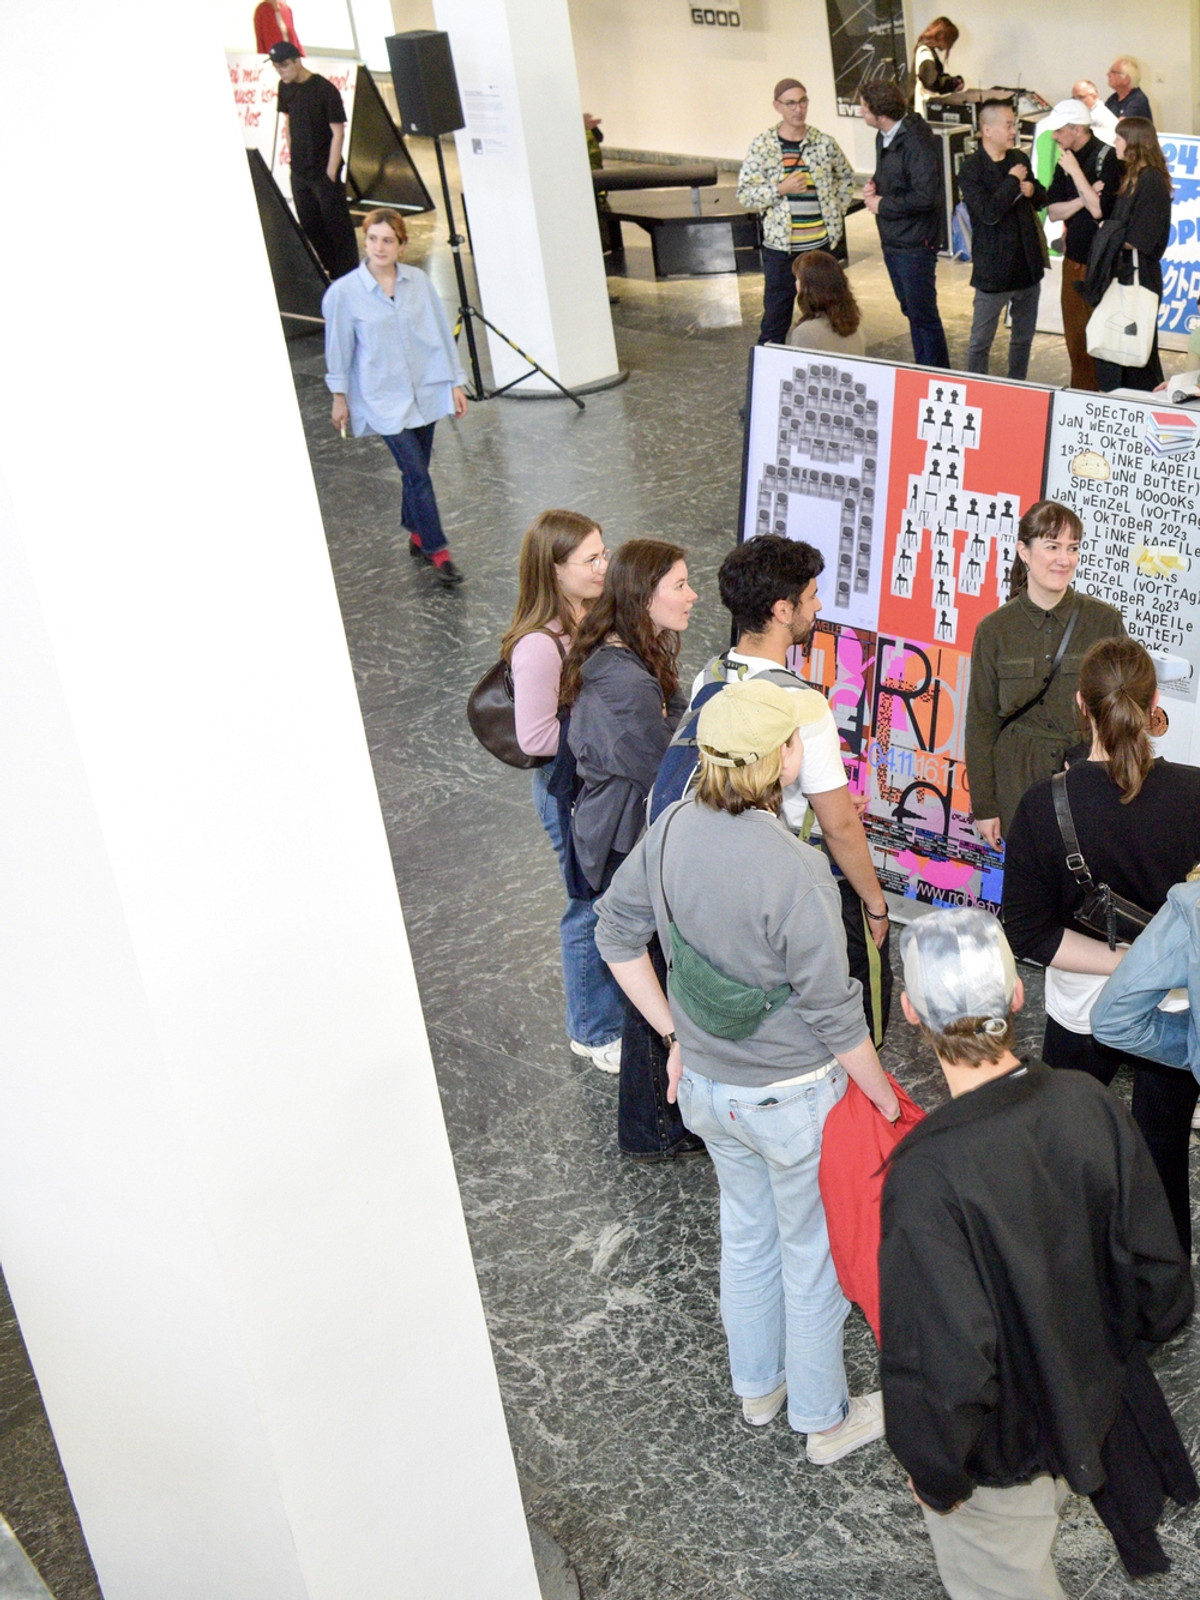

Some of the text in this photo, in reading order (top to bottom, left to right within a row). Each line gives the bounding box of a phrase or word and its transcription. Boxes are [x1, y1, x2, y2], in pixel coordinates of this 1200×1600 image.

[691, 8, 740, 27] GOOD
[838, 104, 862, 116] EVE
[1164, 143, 1198, 175] 24
[1058, 415, 1083, 428] JaN
[1077, 432, 1093, 446] 31.
[1100, 435, 1155, 456] OkToBe
[1103, 452, 1143, 469] iNkE
[1112, 472, 1136, 484] uNd
[1052, 488, 1076, 503] JaN
[1160, 523, 1187, 541] 2023
[1079, 540, 1129, 558] oT uNd
